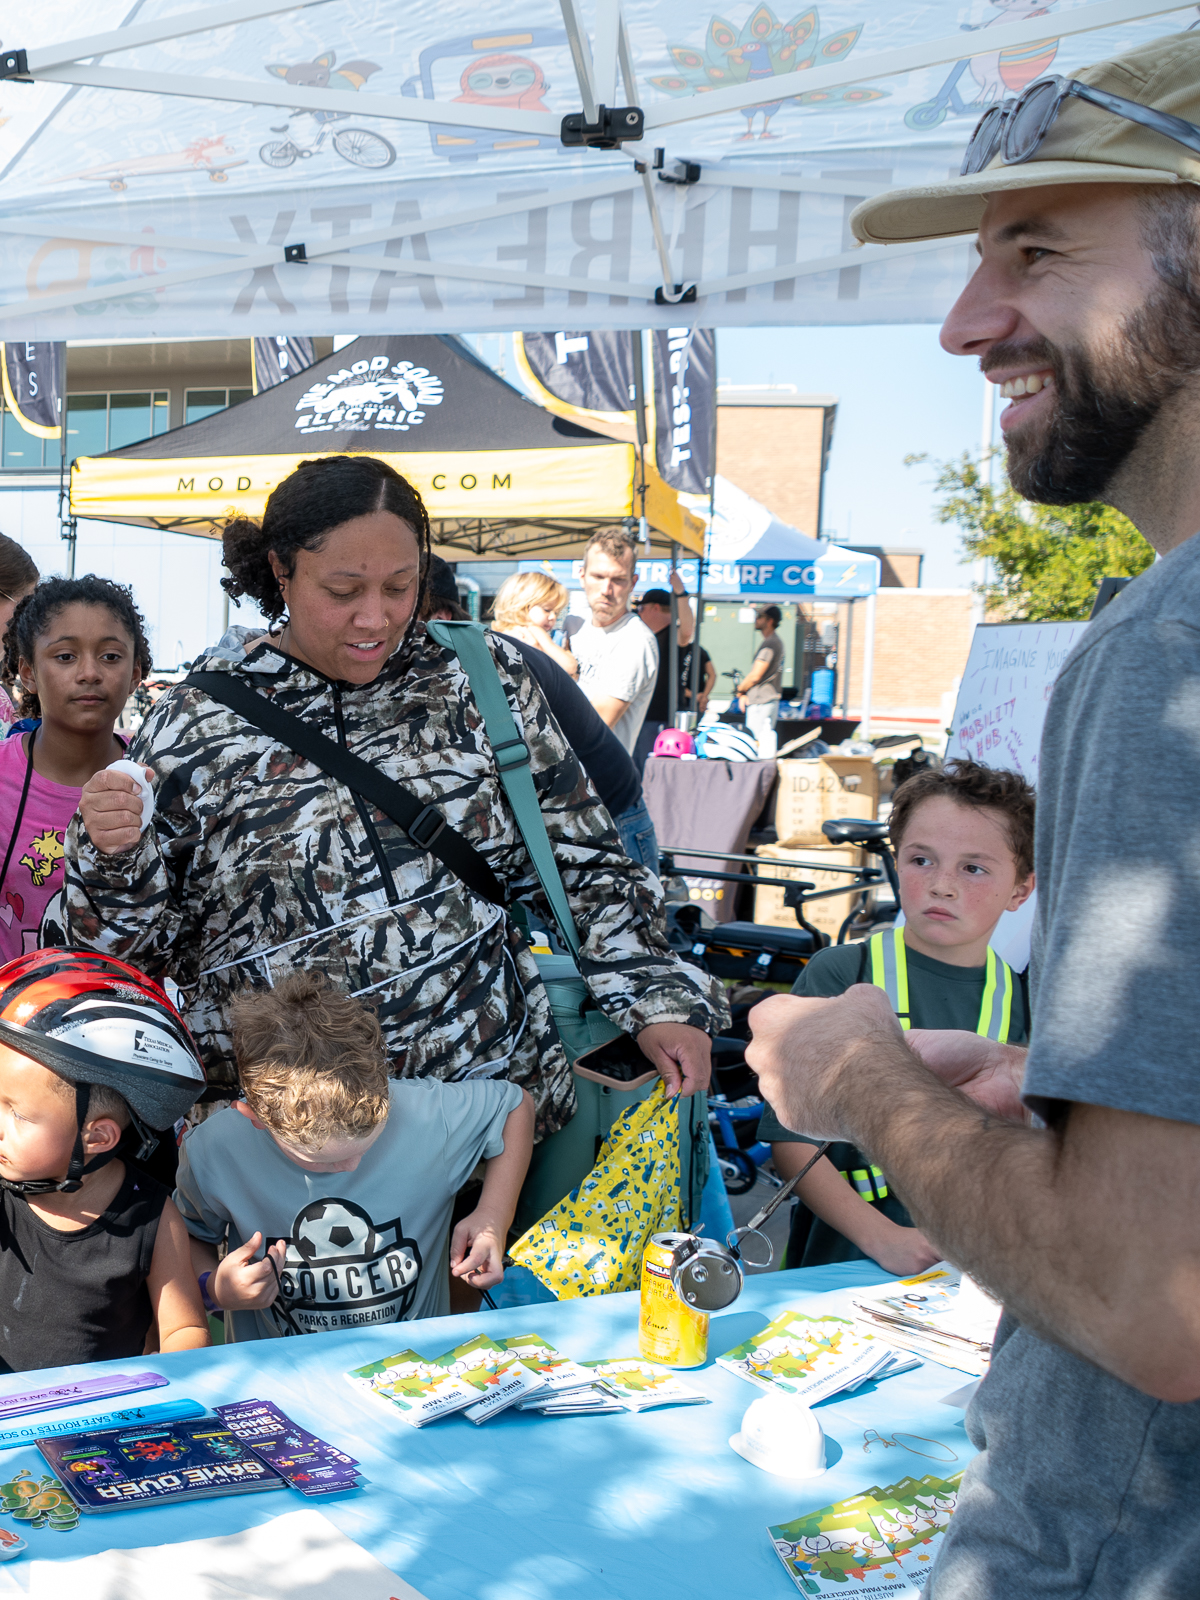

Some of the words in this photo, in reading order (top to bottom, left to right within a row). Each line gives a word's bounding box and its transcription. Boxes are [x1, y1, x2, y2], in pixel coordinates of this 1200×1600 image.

[295, 383, 337, 411] THE
[327, 356, 390, 384] MOD
[391, 360, 445, 406] SQUAD
[294, 407, 427, 428] ELECTRIC
[706, 562, 775, 585] SURF
[782, 563, 824, 586] CO
[978, 646, 1038, 671] IMAGINE
[959, 697, 1016, 750] MOBILITY
[976, 728, 1002, 759] HUB
[143, 1042, 171, 1053] ASSOCIATION
[144, 1036, 157, 1044] TEXAS
[156, 1039, 174, 1050] MEDICAL
[279, 1254, 406, 1301] SOCCER
[643, 1275, 676, 1292] SPARKLIN
[648, 1286, 673, 1300] WATER
[298, 1312, 329, 1327] PARKS
[330, 1314, 338, 1326] &
[339, 1303, 396, 1326] RECREATION
[644, 1316, 669, 1331] lemon
[500, 1380, 522, 1394] BIKE
[443, 1390, 463, 1401] BIKE
[479, 1390, 501, 1406] MAP
[421, 1398, 443, 1410] MAP
[36, 1420, 81, 1434] ROUTES
[81, 1415, 111, 1427] SAFE
[227, 1416, 276, 1431] GAME
[20, 1427, 37, 1437] TO
[234, 1423, 285, 1438] OVER
[144, 1471, 168, 1480] driving
[167, 1464, 202, 1475] distracted
[181, 1461, 266, 1483] GAME
[122, 1475, 144, 1483] starts
[187, 1479, 212, 1488] your
[231, 1474, 261, 1482] Don't
[95, 1474, 182, 1499] OVER
[158, 1485, 185, 1495] next
[133, 1490, 157, 1499] ride
[815, 1588, 859, 1600] BICICLETAS
[859, 1585, 881, 1595] PARA
[880, 1582, 907, 1592] MAPA
